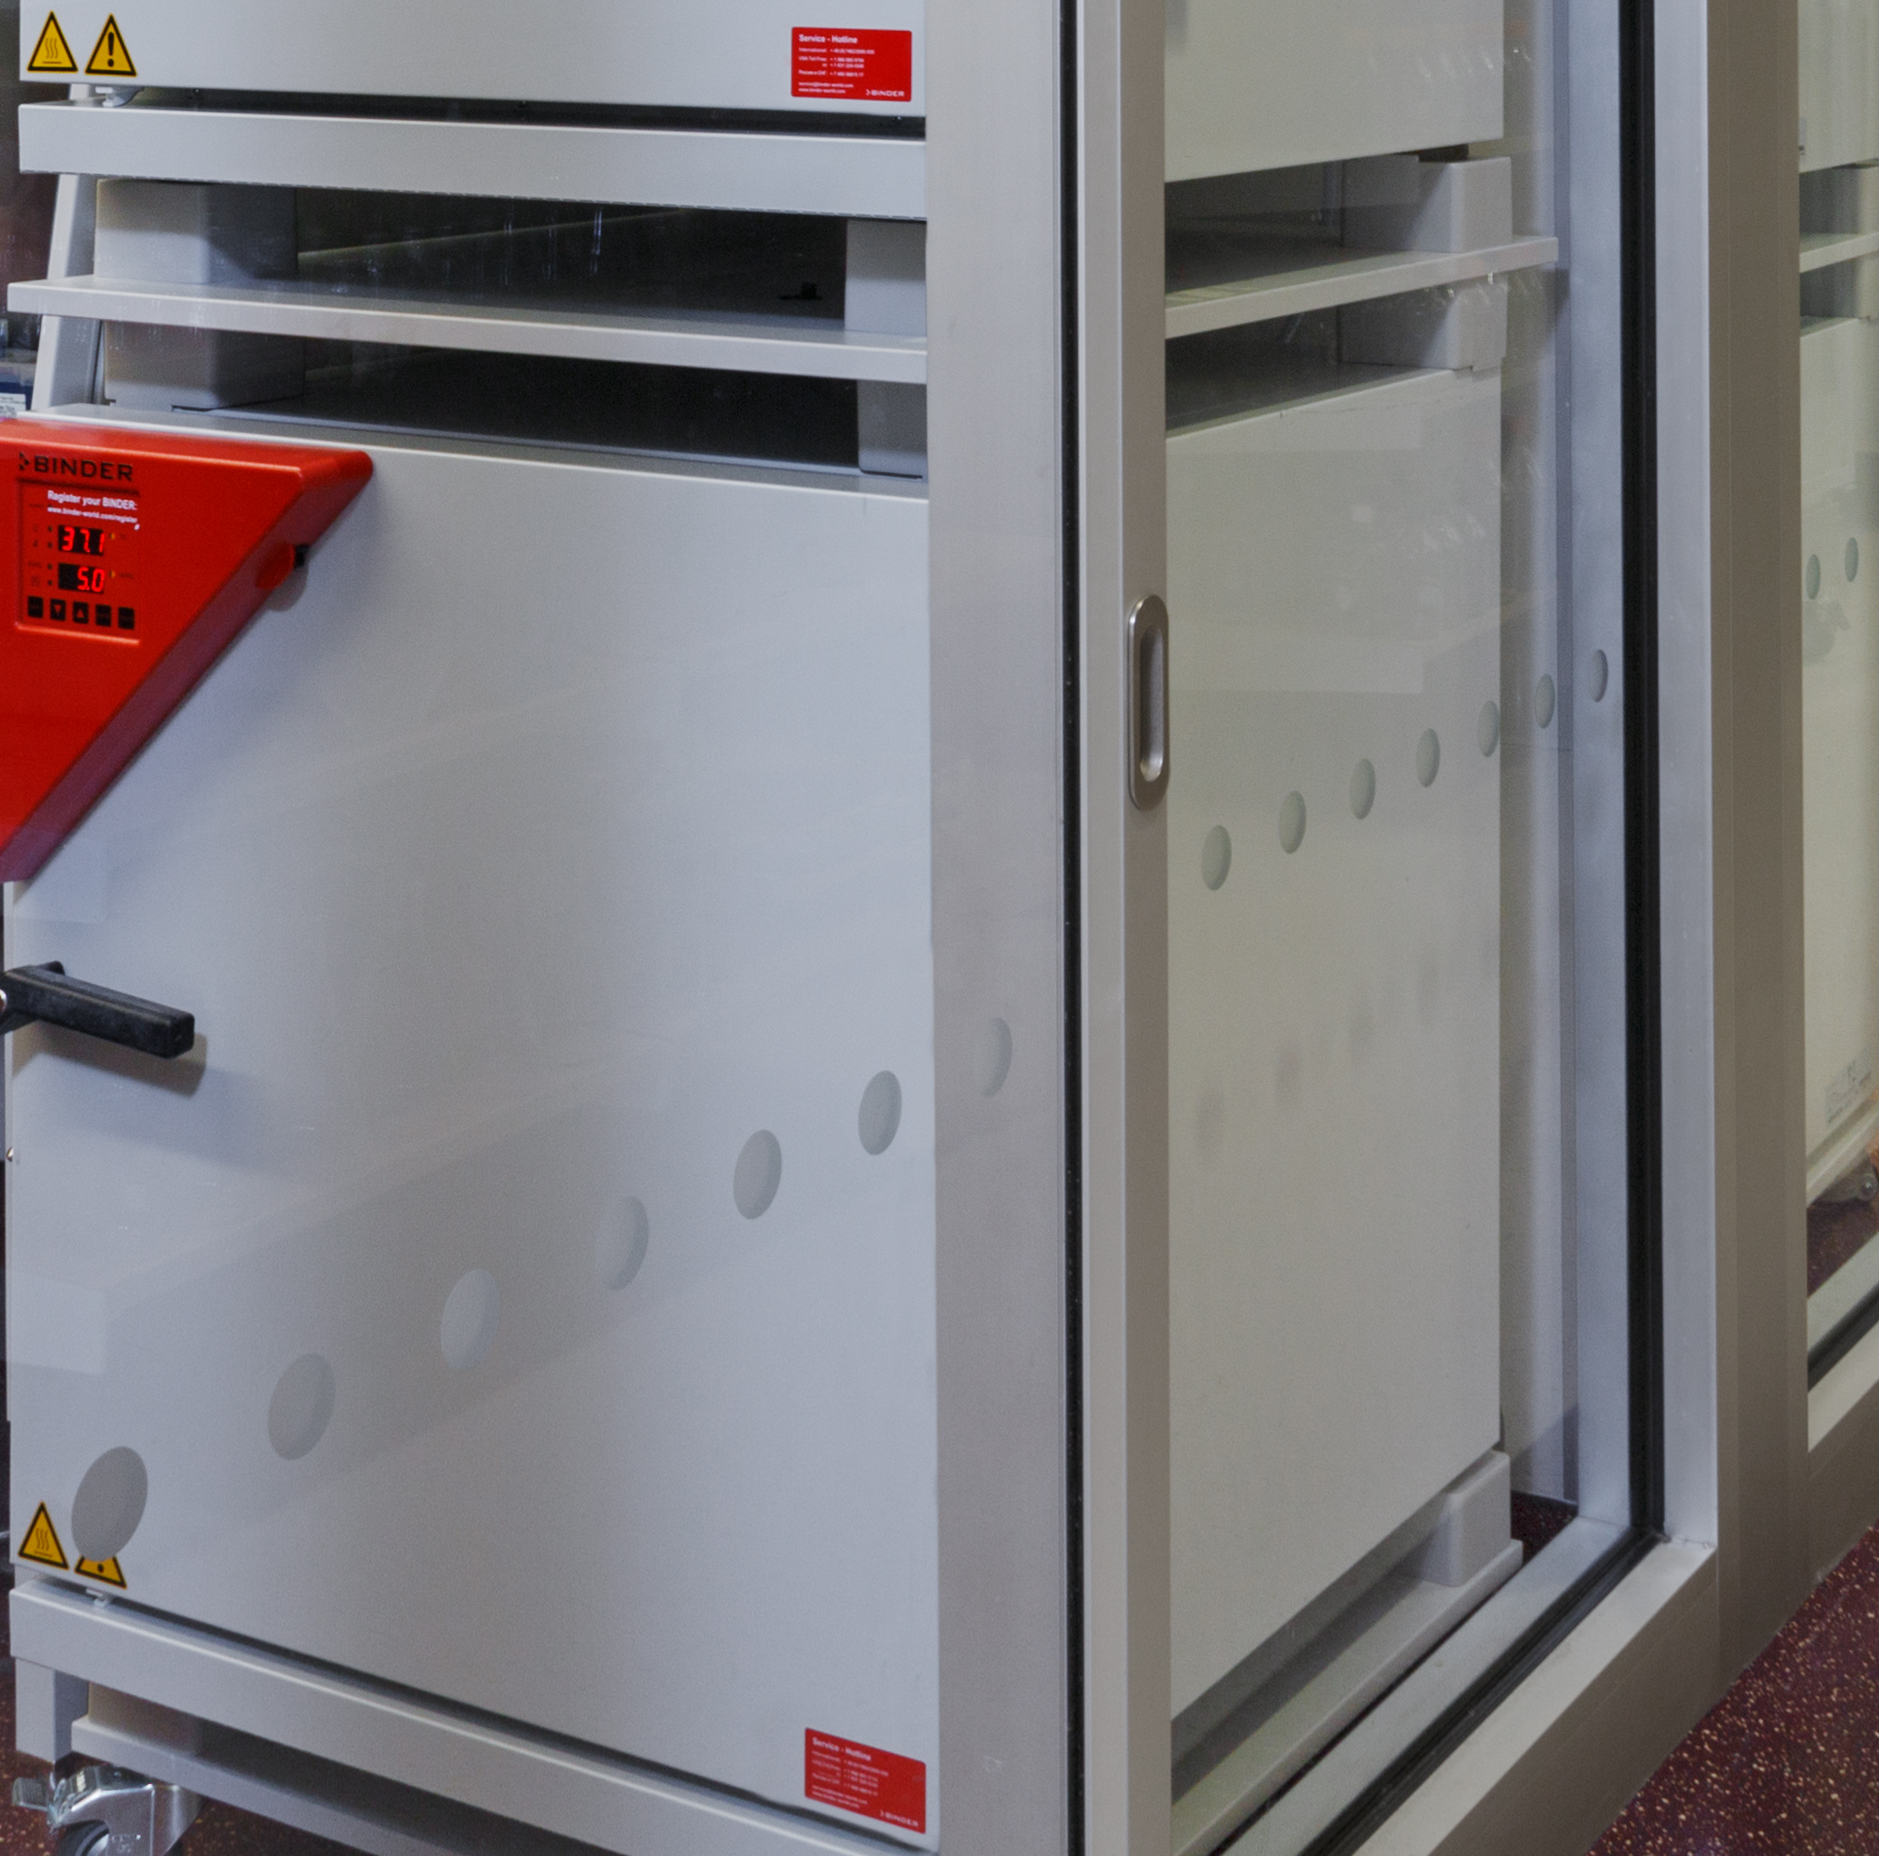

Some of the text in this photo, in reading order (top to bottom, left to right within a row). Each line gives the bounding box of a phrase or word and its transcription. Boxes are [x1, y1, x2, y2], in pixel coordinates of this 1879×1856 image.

[799, 34, 826, 43] Service
[831, 35, 858, 44] Hotline
[871, 89, 905, 97] BINDER
[34, 454, 134, 482] BINDER
[47, 490, 138, 511] Register your BINDER:
[812, 1736, 840, 1752] Service
[845, 1747, 872, 1761] Hotline
